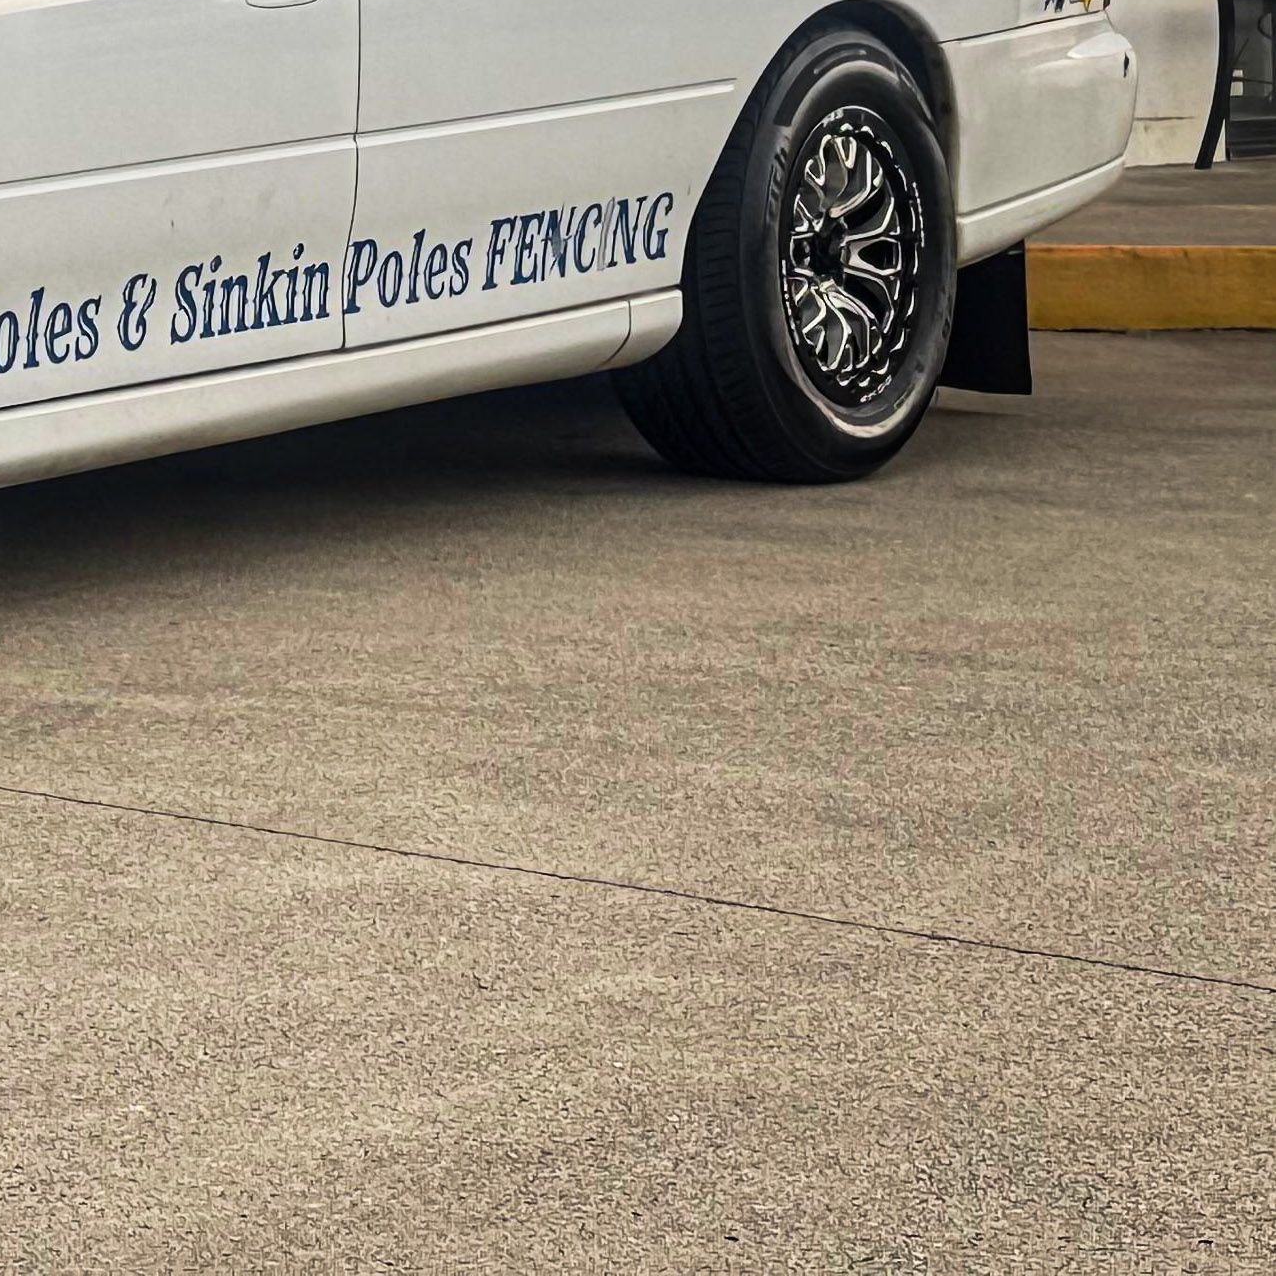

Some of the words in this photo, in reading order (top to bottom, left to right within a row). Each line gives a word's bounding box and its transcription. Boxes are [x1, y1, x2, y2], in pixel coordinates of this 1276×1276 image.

[123, 272, 157, 349] &
[170, 243, 333, 345] Sinkin
[340, 231, 471, 316] Poles
